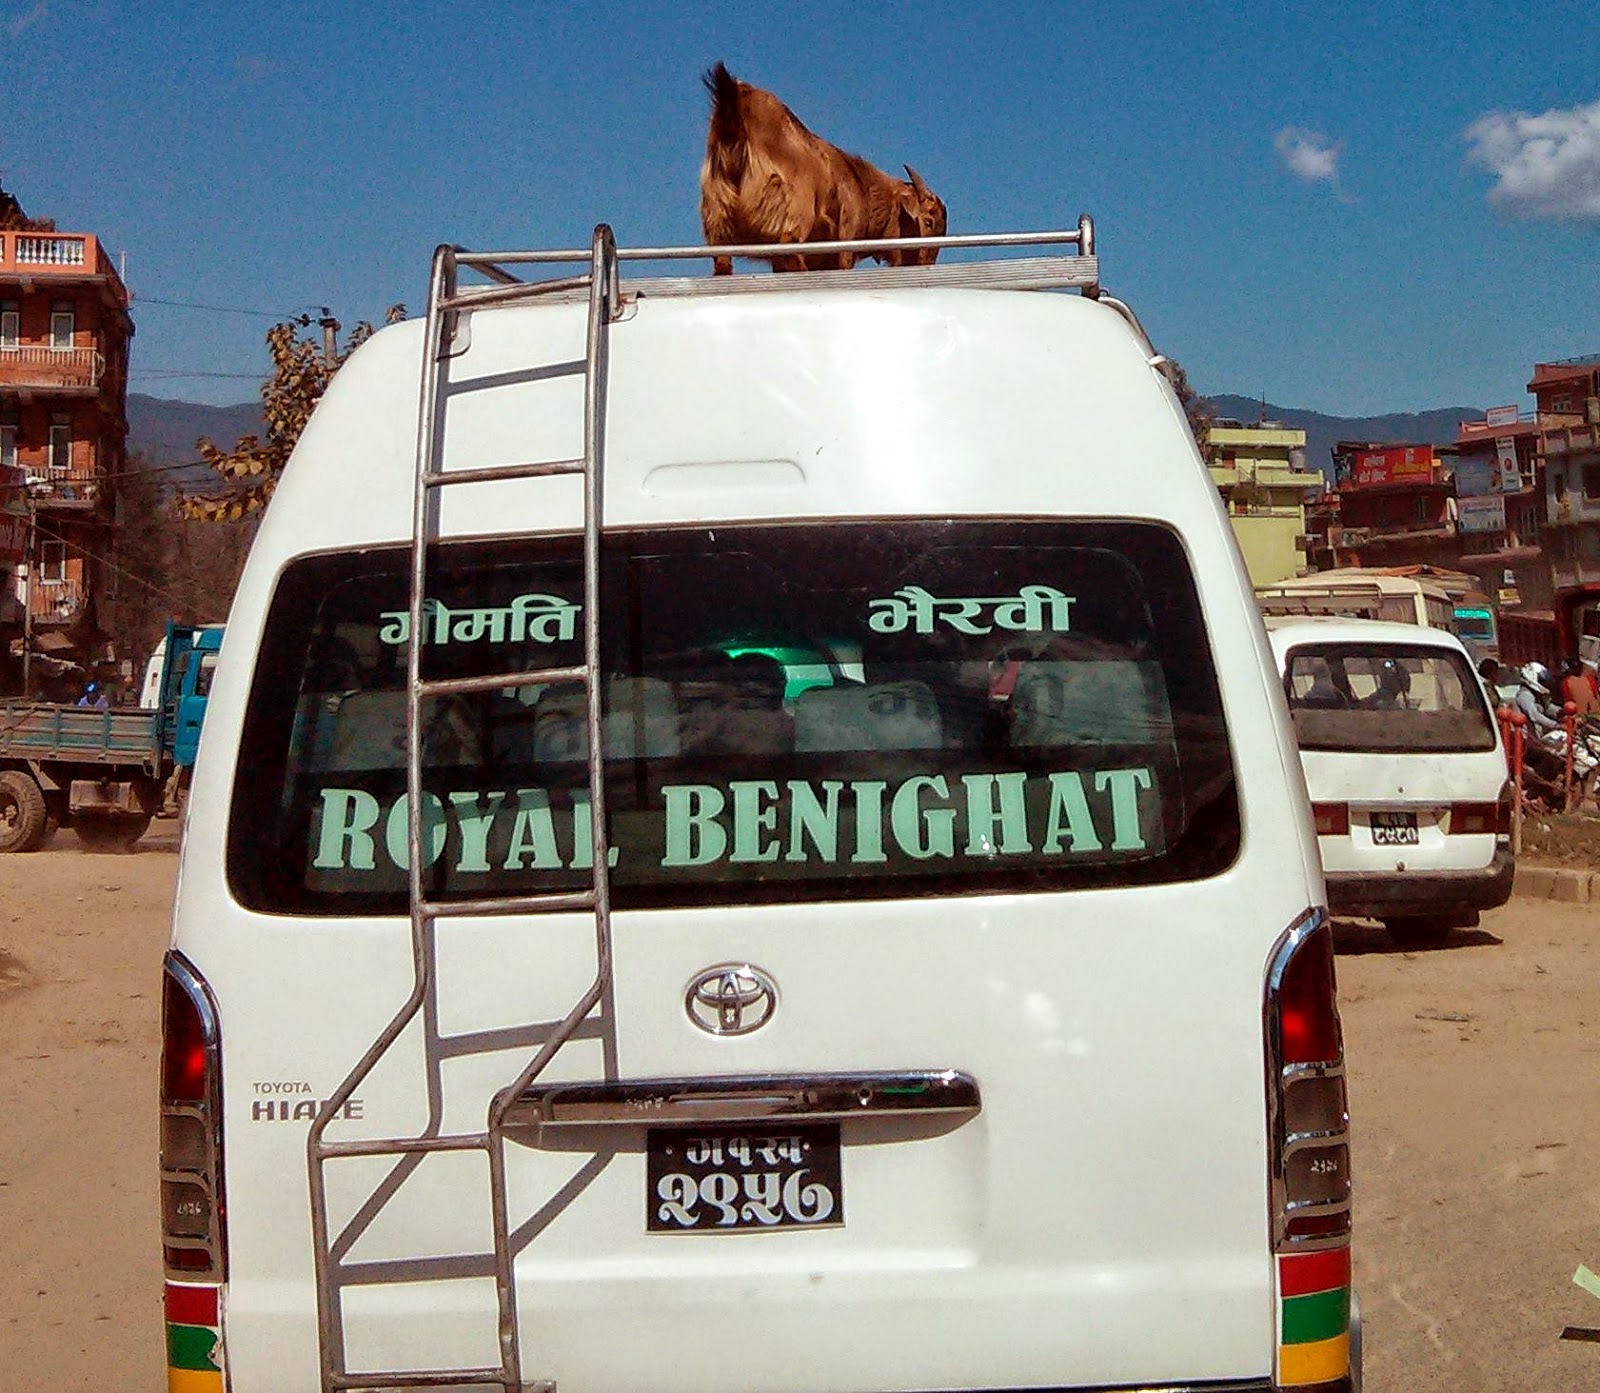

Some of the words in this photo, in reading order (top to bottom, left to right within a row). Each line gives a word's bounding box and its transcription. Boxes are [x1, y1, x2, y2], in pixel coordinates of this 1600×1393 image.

[868, 585, 1077, 635] भैरवी
[313, 788, 619, 872] ROYAL
[660, 768, 1152, 867] BENIGHAT
[253, 1082, 312, 1094] TOYOTA
